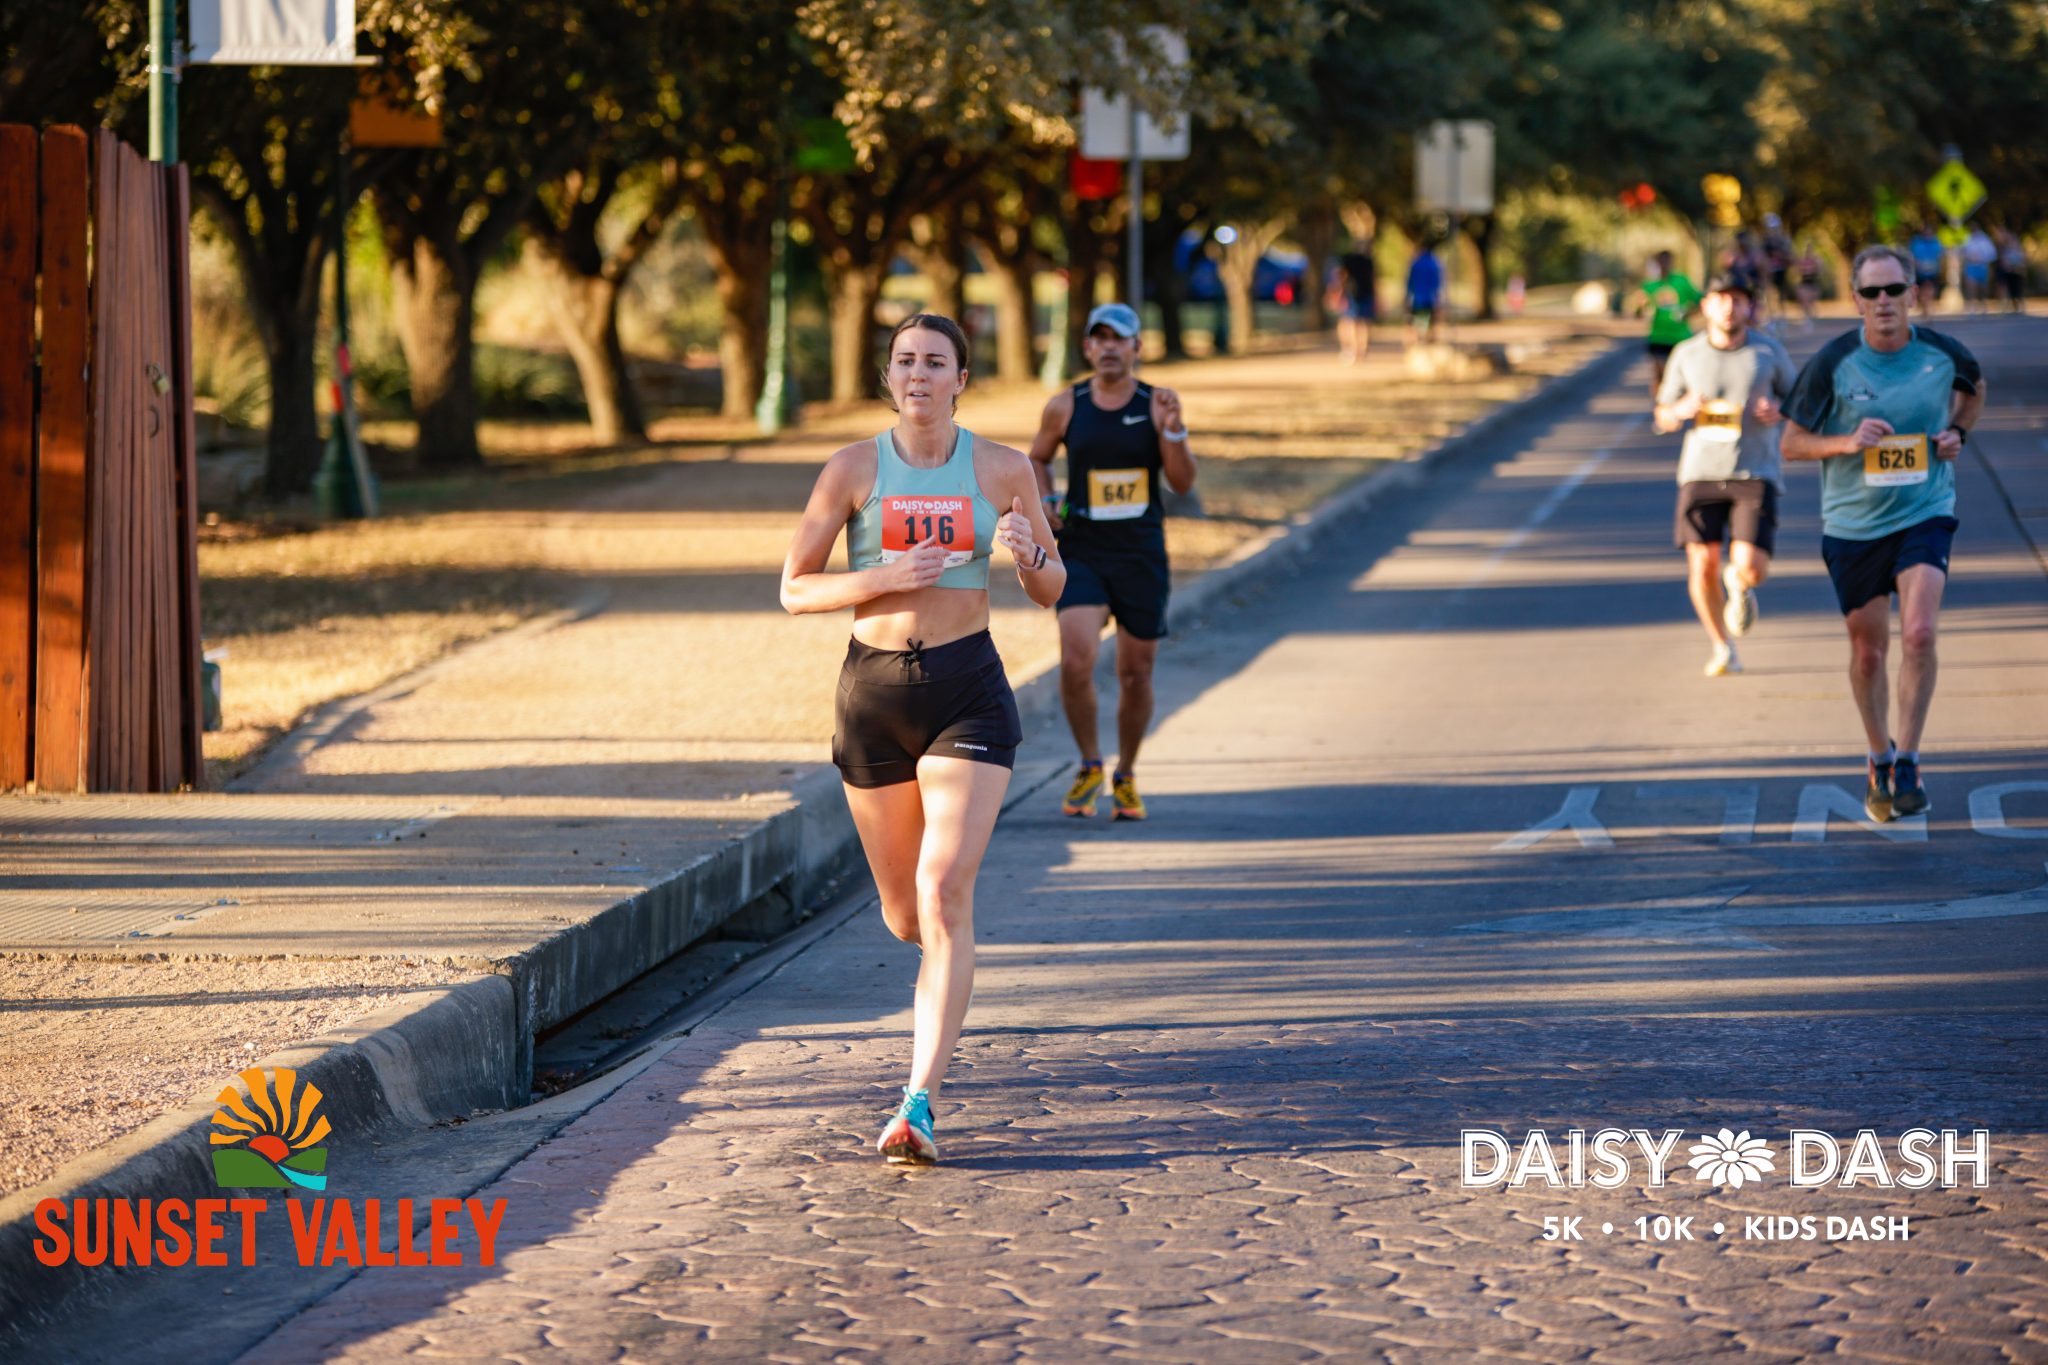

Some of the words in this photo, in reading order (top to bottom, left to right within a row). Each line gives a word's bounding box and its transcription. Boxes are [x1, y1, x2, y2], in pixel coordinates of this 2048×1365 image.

[1879, 448, 1915, 469] 626
[1104, 484, 1137, 502] 647
[892, 500, 924, 510] DAISY
[934, 501, 962, 510] DASH
[905, 516, 954, 545] 116
[954, 742, 988, 751] patagonia
